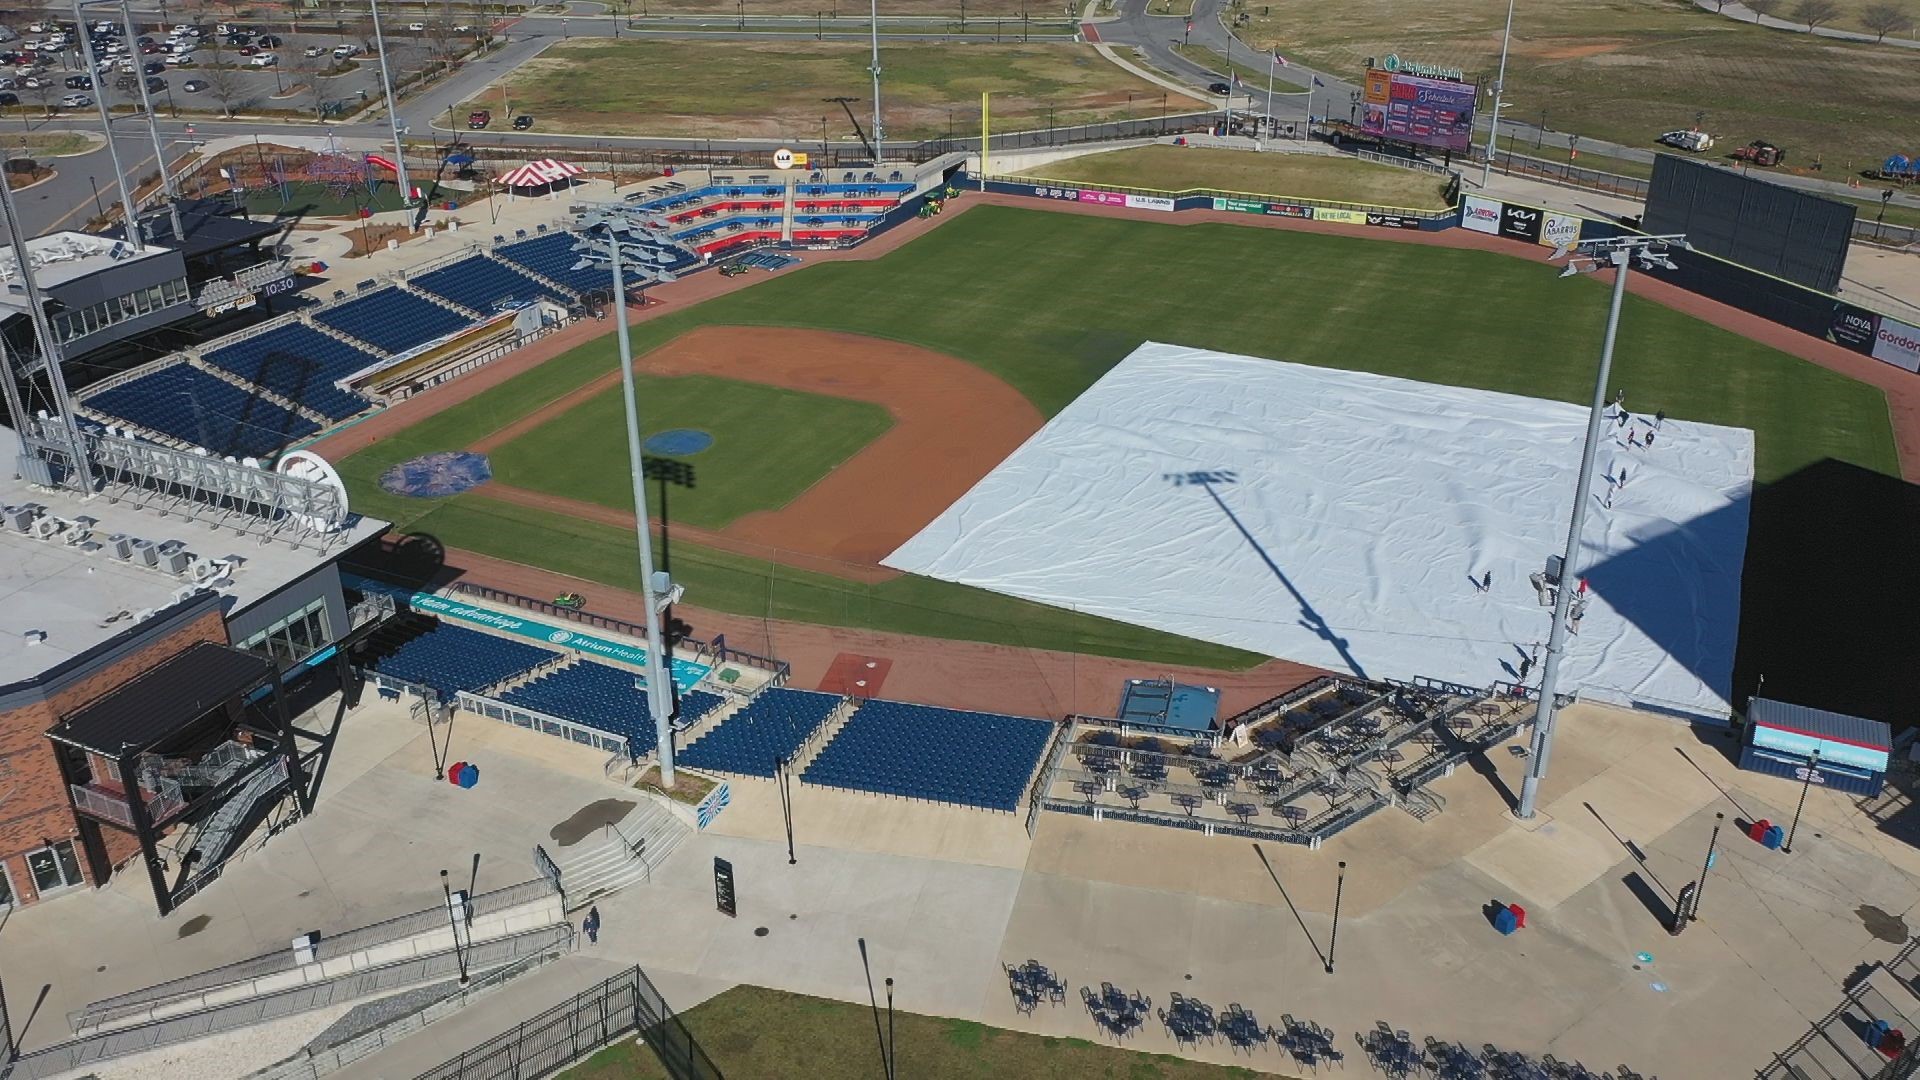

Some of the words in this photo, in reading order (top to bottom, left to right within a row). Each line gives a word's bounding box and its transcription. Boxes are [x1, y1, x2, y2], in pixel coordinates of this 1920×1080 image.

[265, 278, 294, 296] 10:30
[1845, 314, 1871, 331] NOVA
[571, 637, 613, 653] Atrium
